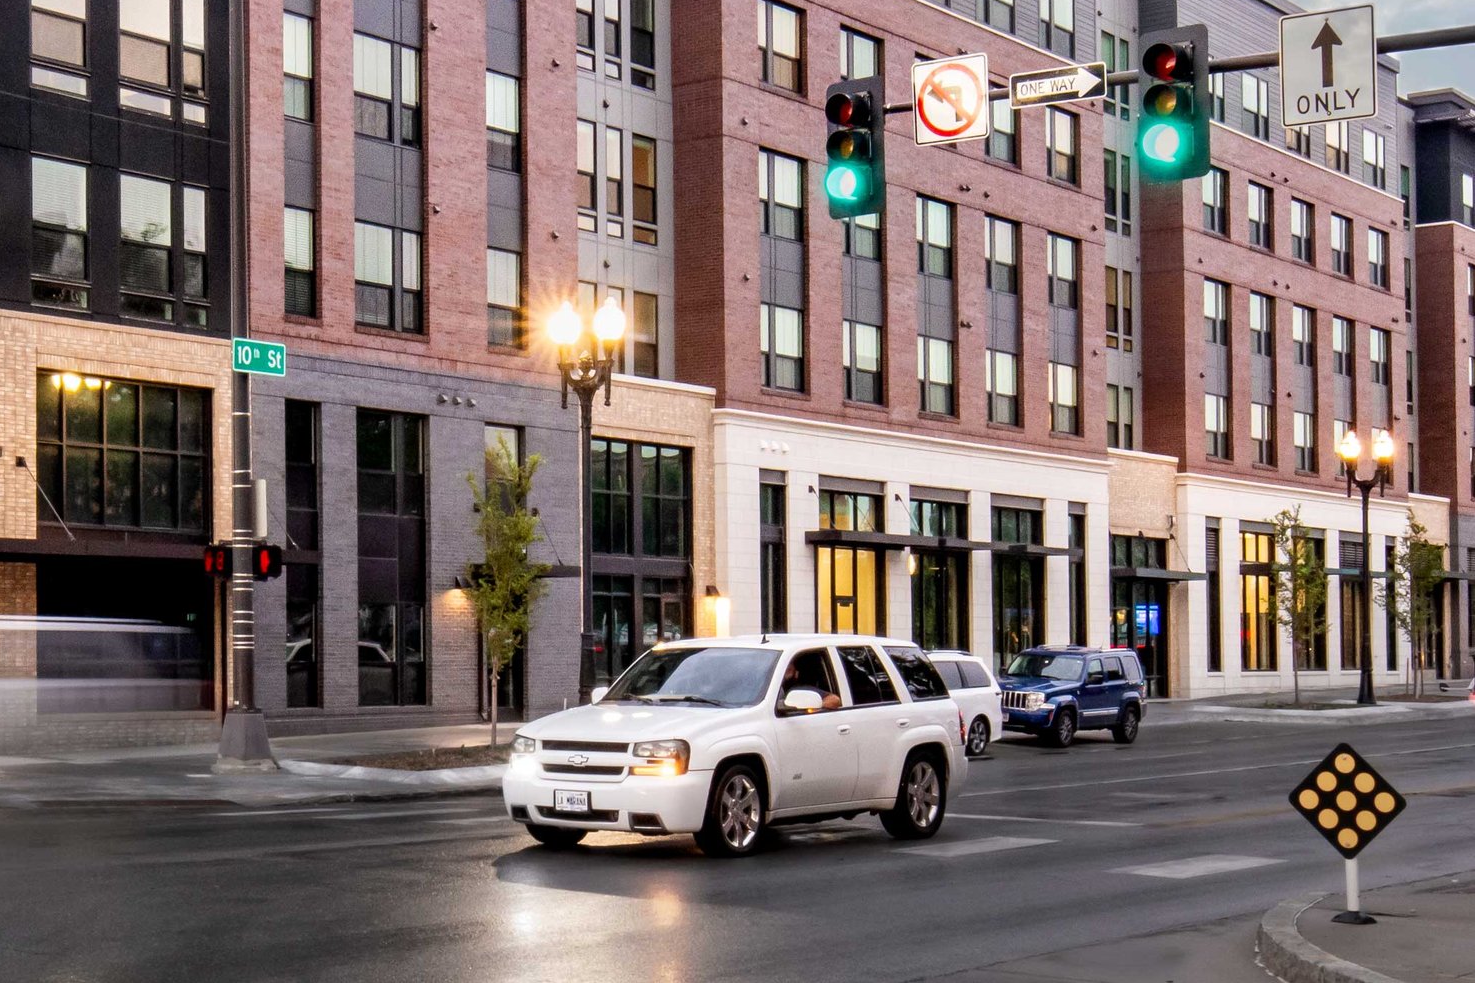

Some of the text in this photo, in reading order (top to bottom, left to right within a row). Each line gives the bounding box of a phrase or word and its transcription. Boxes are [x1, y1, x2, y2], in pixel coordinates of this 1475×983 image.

[1020, 77, 1076, 96] ONE WAY
[1297, 88, 1360, 115] ONLY
[237, 345, 282, 369] 10th St
